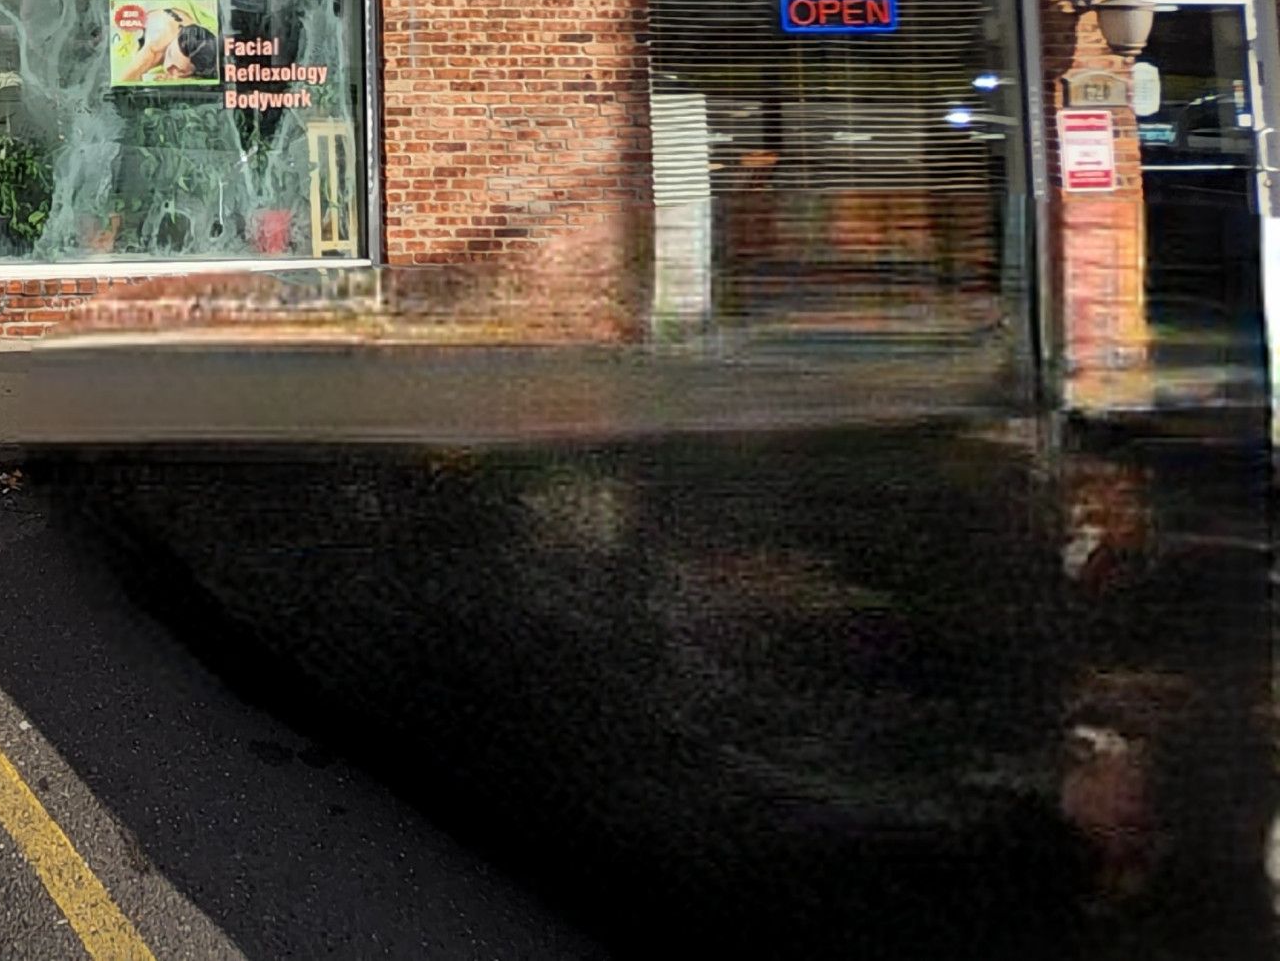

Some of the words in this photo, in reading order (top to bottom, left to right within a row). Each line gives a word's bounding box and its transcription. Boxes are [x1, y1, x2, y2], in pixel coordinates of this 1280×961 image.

[224, 38, 279, 56] Facial
[224, 63, 328, 85] Reflexology
[225, 90, 312, 112] Bodywork
